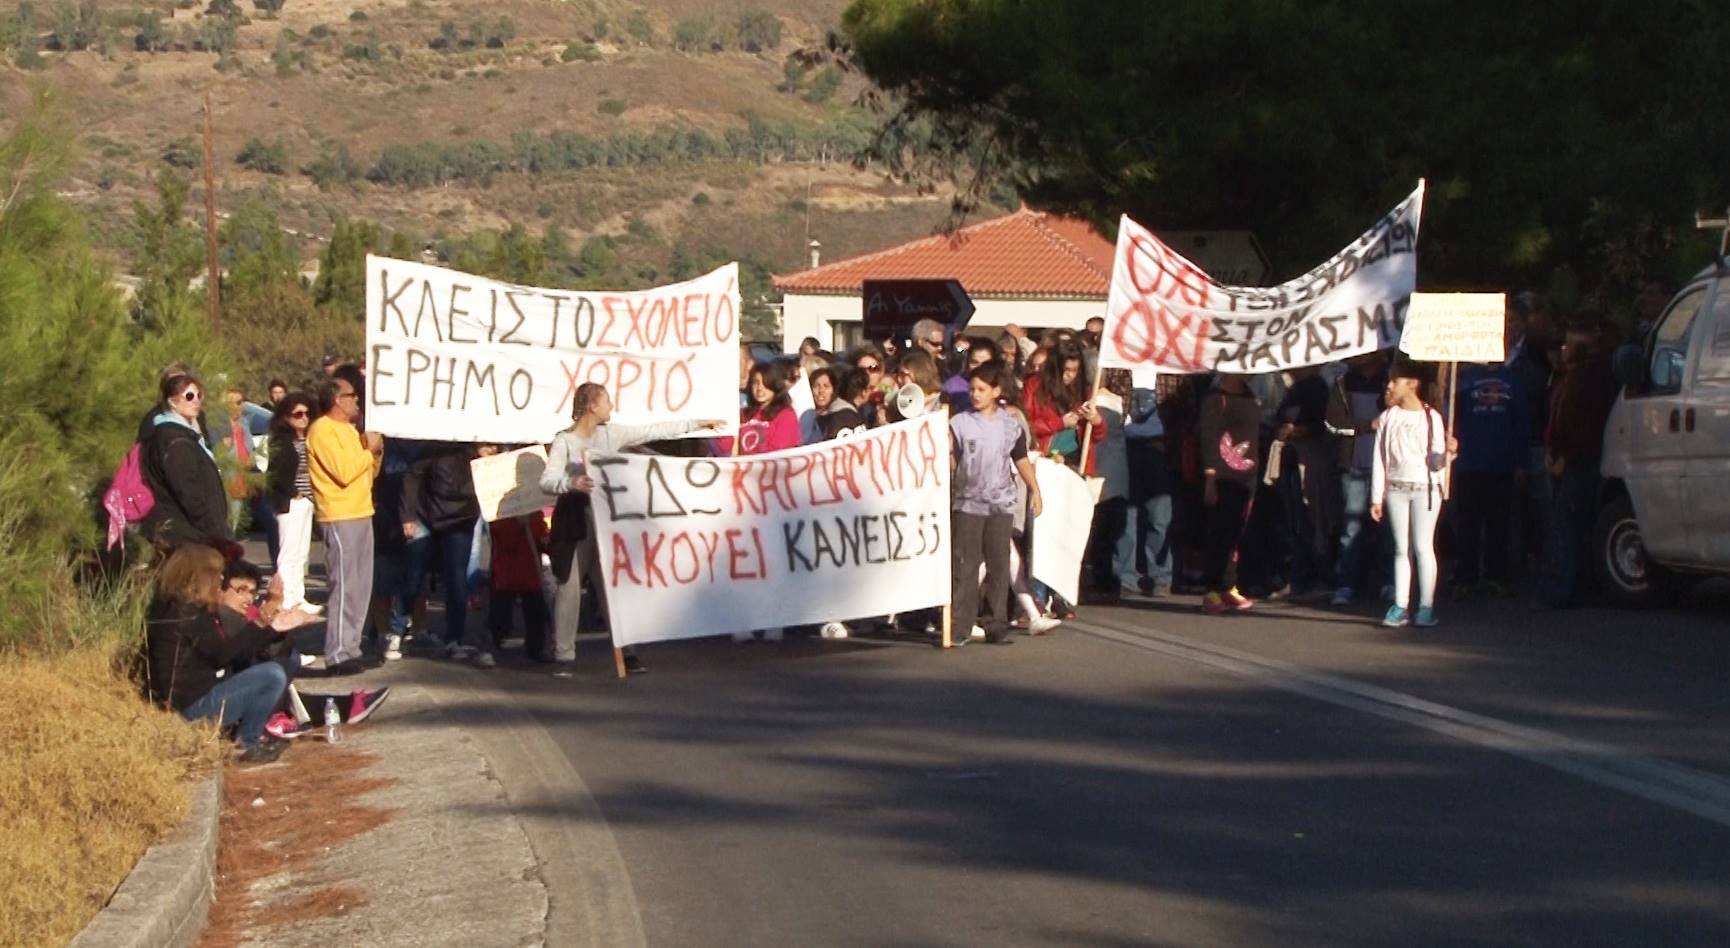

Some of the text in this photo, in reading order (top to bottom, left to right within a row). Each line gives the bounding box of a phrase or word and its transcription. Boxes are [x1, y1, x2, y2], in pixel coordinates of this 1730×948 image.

[380, 269, 595, 348] ΚΛΕΙΣΤΟ
[1113, 301, 1313, 371] ΟΧΙ ΣΤΟΝ
[371, 344, 533, 416] ΕΡΗΜΟ
[591, 420, 942, 521] ΕΔΩ ΚΑΡΔΑΜΥΛΑ
[611, 526, 767, 588] ΑΚΟΥΕΙ
